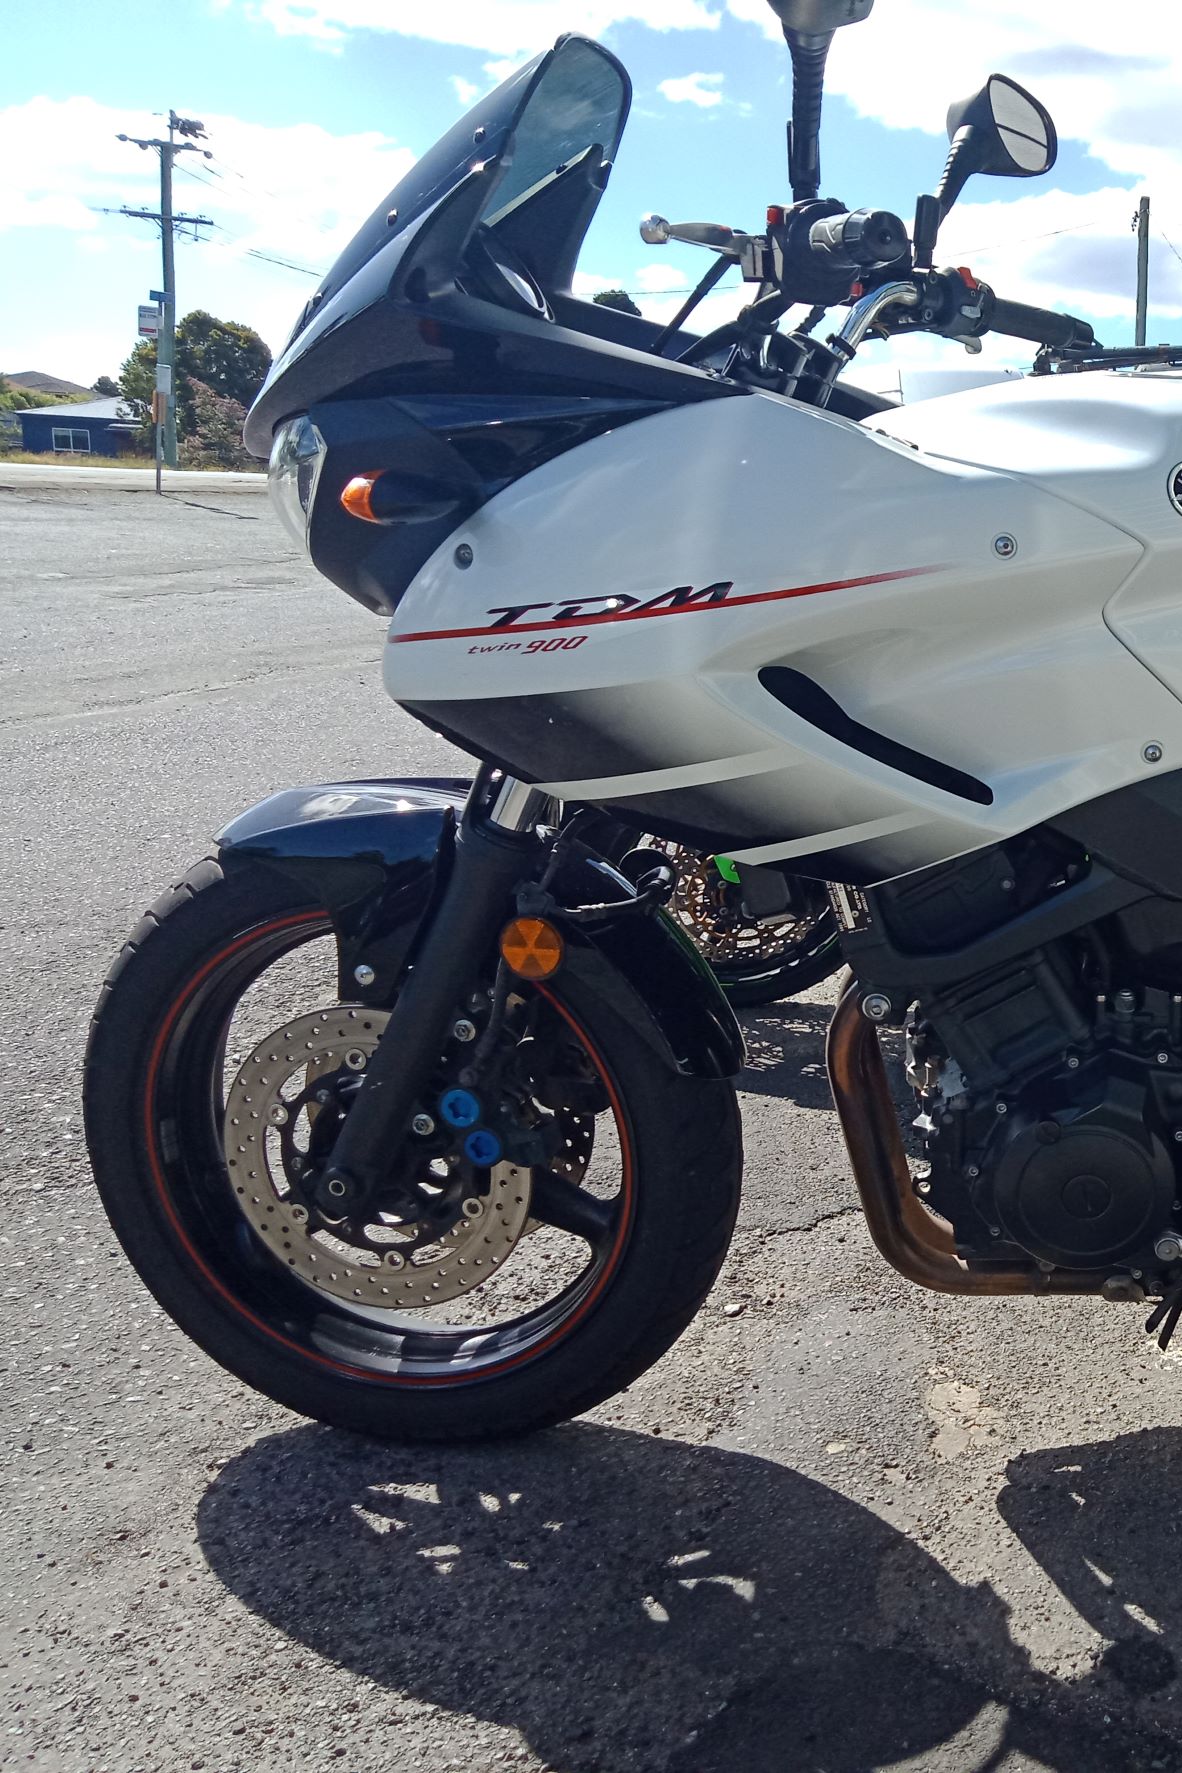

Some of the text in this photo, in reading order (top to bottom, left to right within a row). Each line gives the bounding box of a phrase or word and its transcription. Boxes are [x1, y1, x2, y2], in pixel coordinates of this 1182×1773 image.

[486, 580, 734, 628] TDM
[468, 635, 589, 655] twin 900
